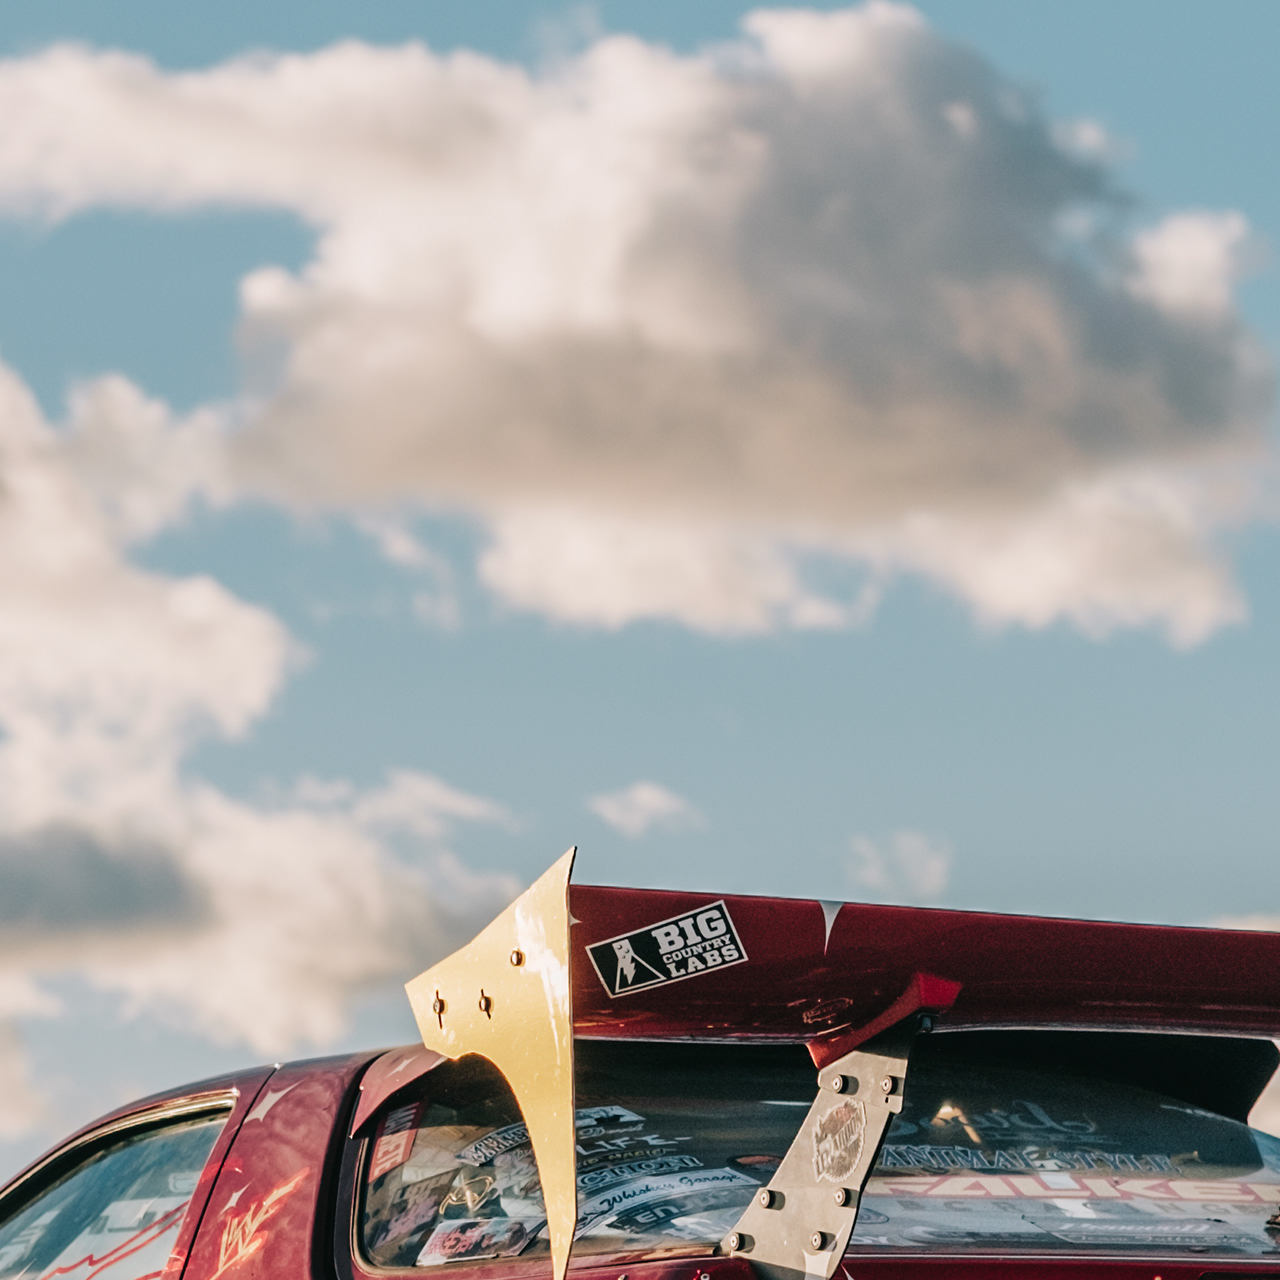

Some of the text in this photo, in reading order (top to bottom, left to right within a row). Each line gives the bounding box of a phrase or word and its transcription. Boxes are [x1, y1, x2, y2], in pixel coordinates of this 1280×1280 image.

[651, 909, 727, 955] BIG
[662, 934, 731, 964] COUNTRY
[665, 944, 739, 978] LABS
[678, 1173, 740, 1188] Garage
